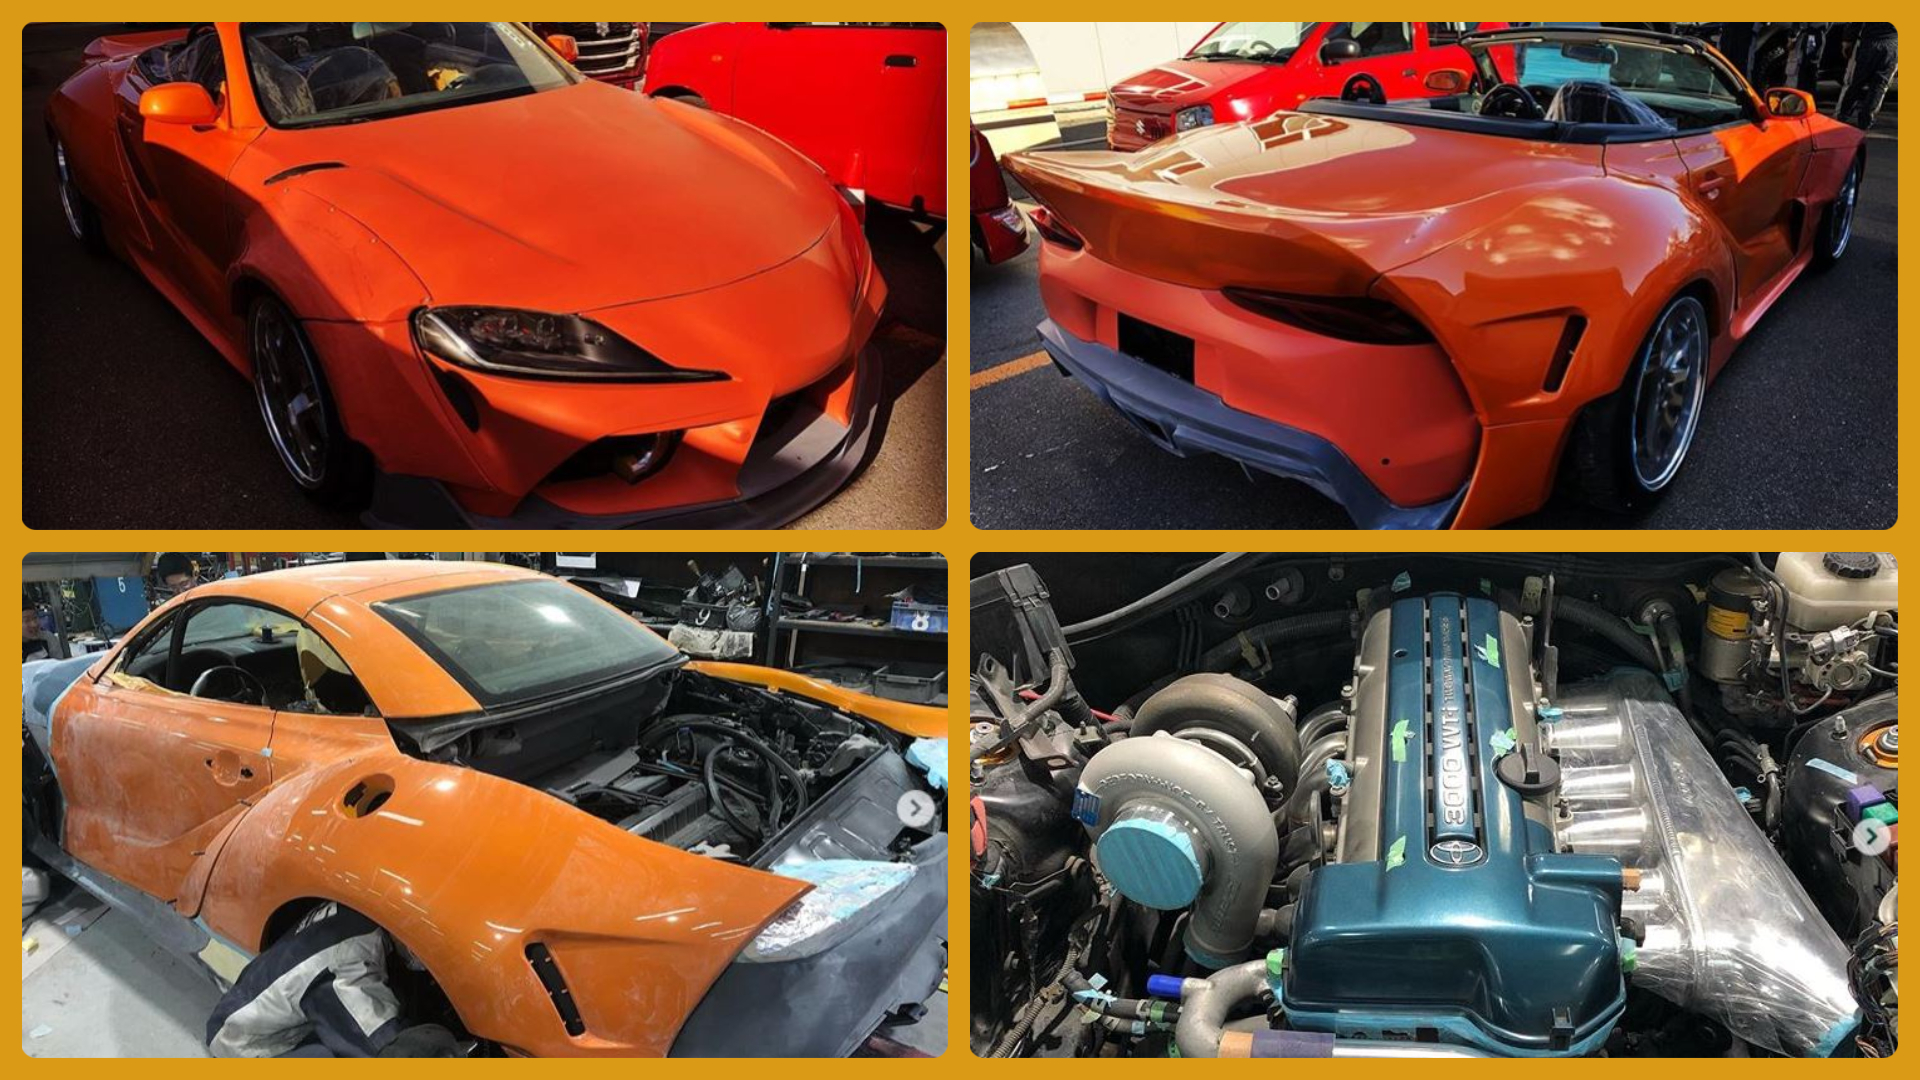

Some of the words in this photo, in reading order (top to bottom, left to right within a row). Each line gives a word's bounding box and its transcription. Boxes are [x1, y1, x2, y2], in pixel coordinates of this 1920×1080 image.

[117, 576, 126, 593] 5
[694, 606, 711, 626] 9
[1442, 758, 1465, 825] 3000
